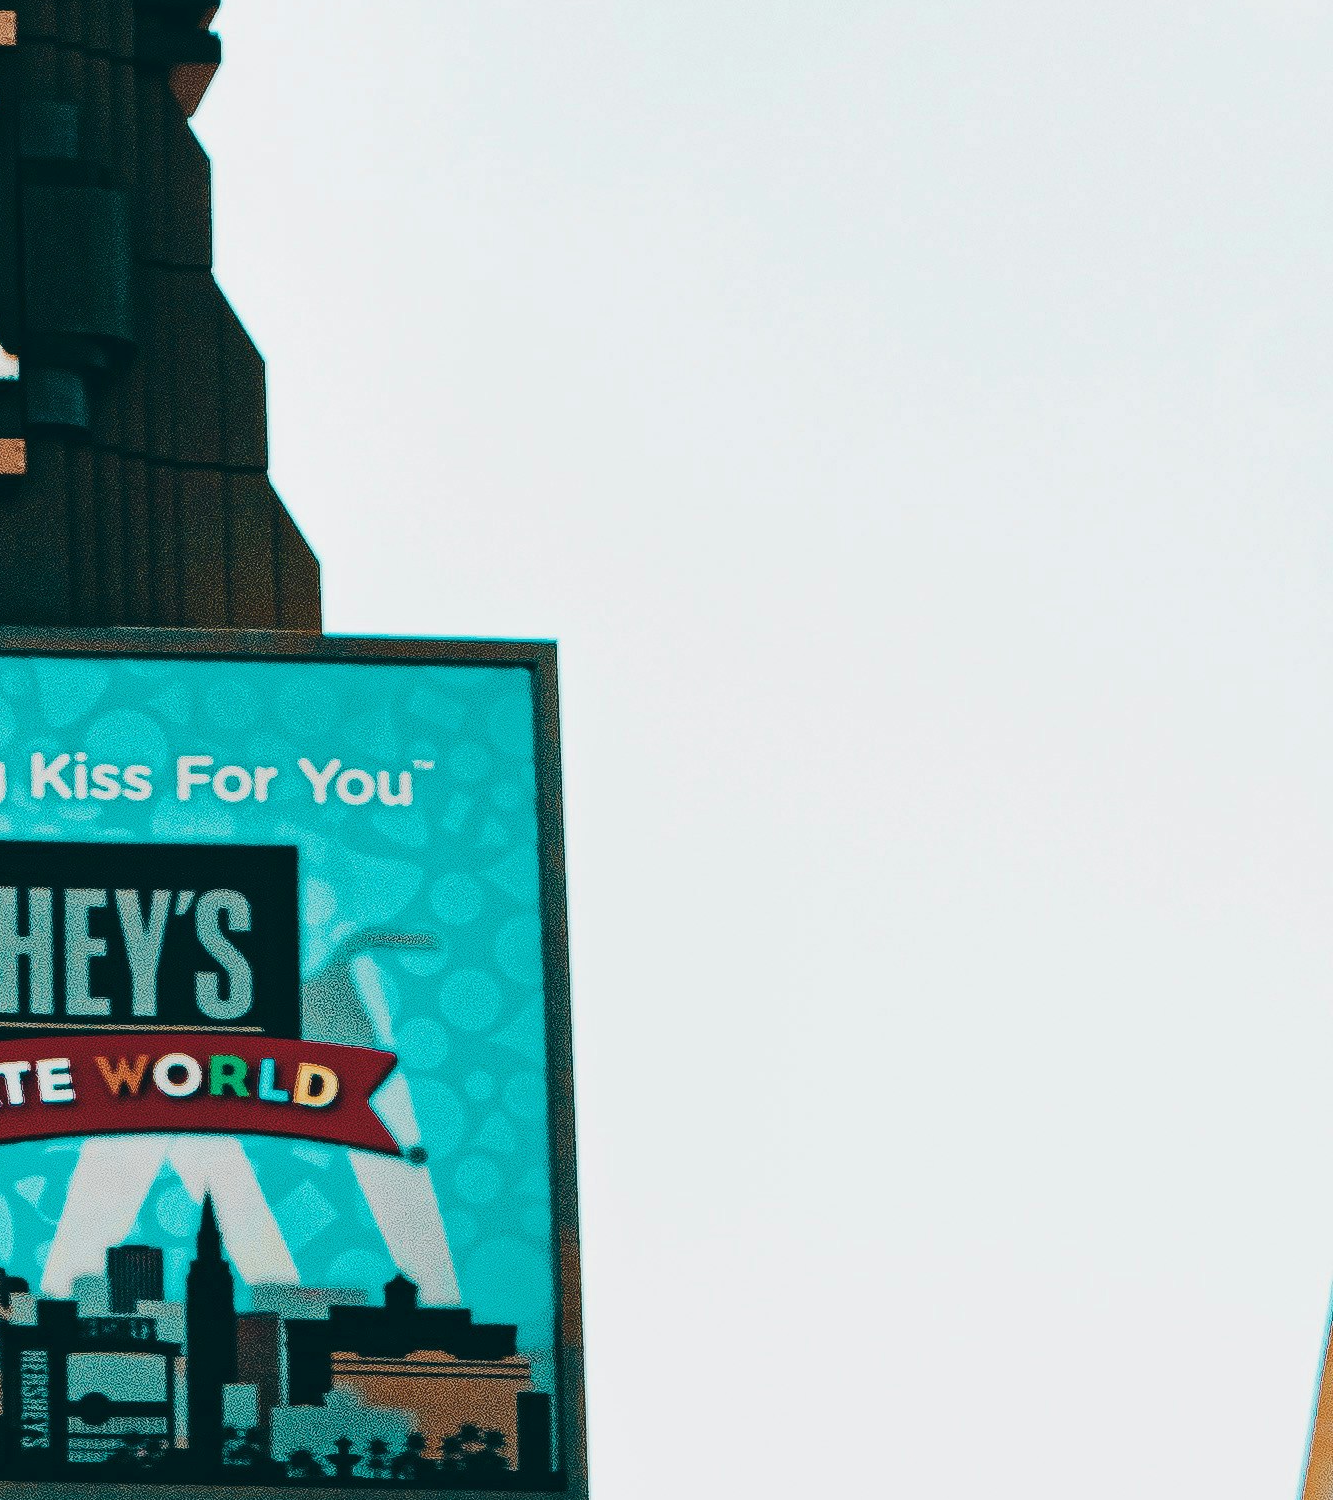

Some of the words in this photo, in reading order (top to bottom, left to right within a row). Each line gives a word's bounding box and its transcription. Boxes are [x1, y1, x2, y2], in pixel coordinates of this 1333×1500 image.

[31, 753, 152, 800] Kiss
[177, 756, 277, 802] For
[94, 1053, 339, 1108] WORLD
